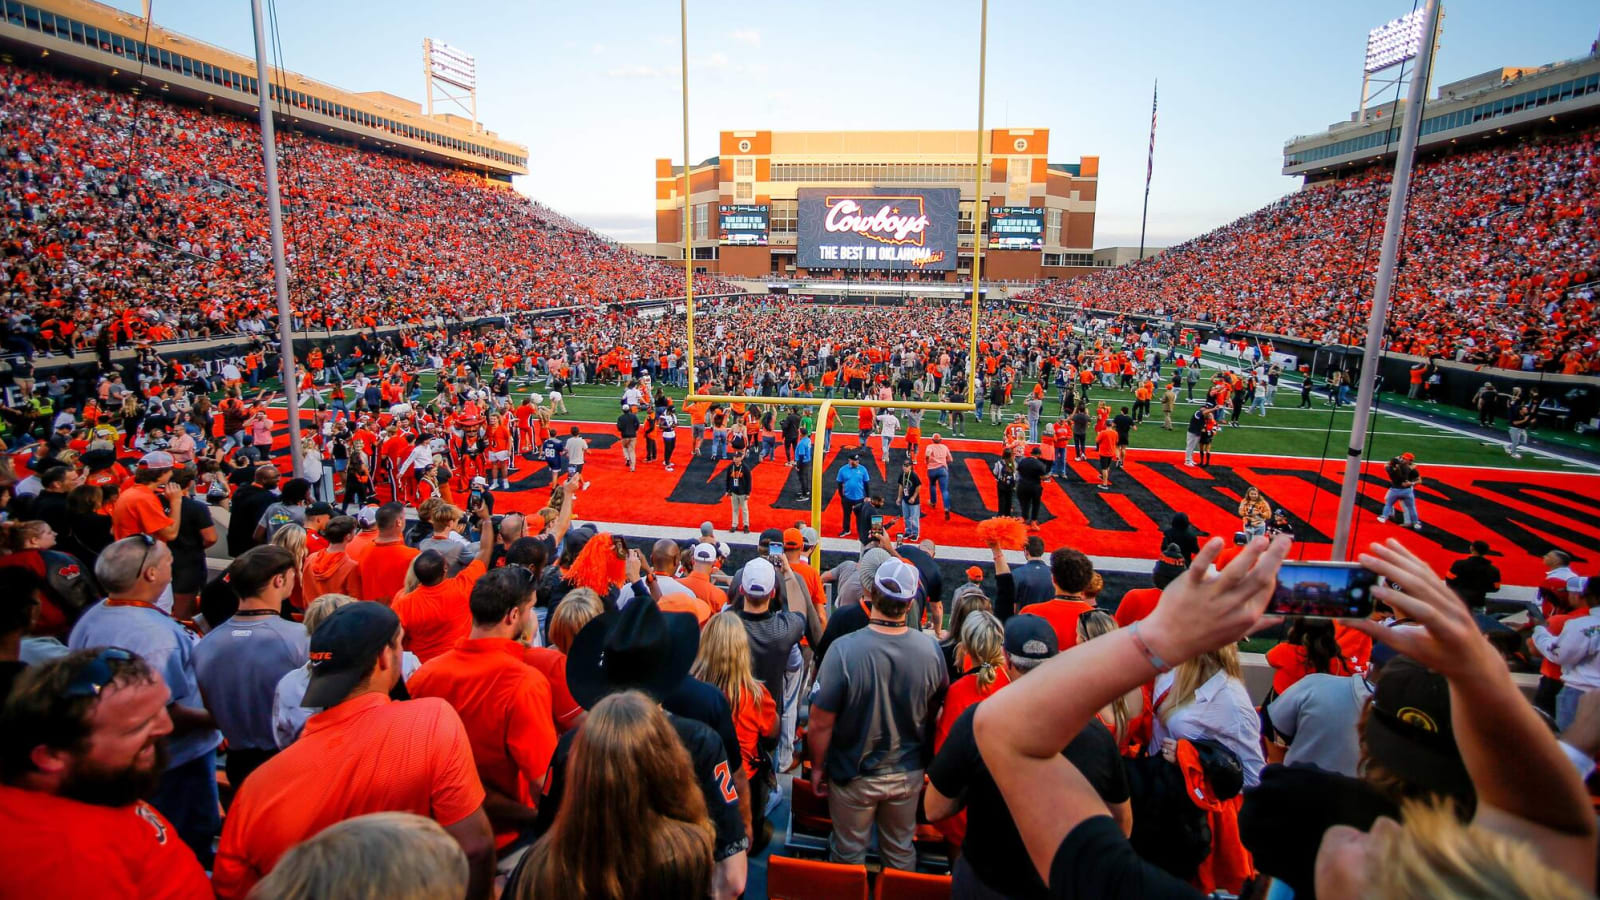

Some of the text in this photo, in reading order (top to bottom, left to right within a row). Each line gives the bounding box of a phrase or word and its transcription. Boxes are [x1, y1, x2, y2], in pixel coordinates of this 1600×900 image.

[825, 199, 930, 240] Cowboys
[819, 246, 931, 261] THE BEST IN OKLAHOMA
[545, 448, 555, 458] 88
[714, 760, 738, 803] 2
